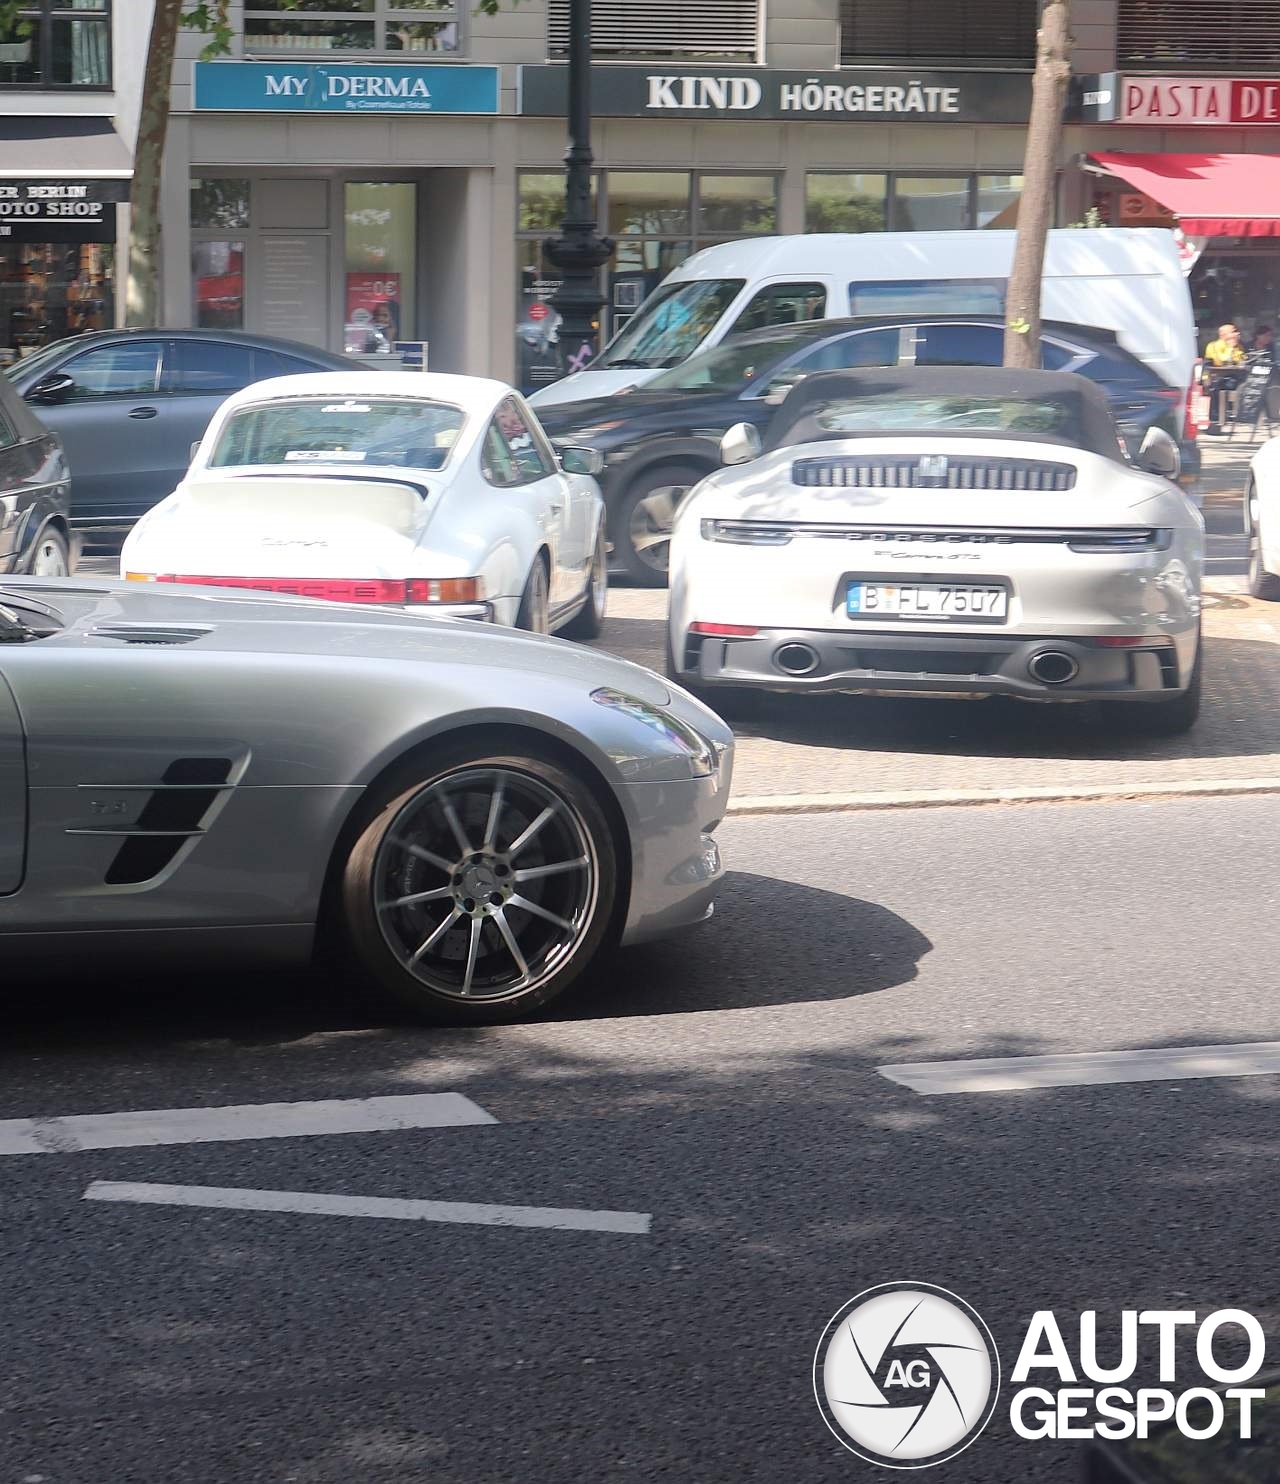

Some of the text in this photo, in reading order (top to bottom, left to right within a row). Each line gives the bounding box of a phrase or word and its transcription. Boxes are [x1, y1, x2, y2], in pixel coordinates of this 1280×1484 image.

[328, 77, 431, 97] DERMA
[646, 76, 960, 113] KIND HÖRGERÄTE
[1128, 85, 1218, 117] PASTA
[27, 186, 87, 198] BERLIN
[47, 202, 103, 216] SHOP
[846, 533, 1012, 545] PORSCHE
[865, 585, 1000, 613] B FL 7507
